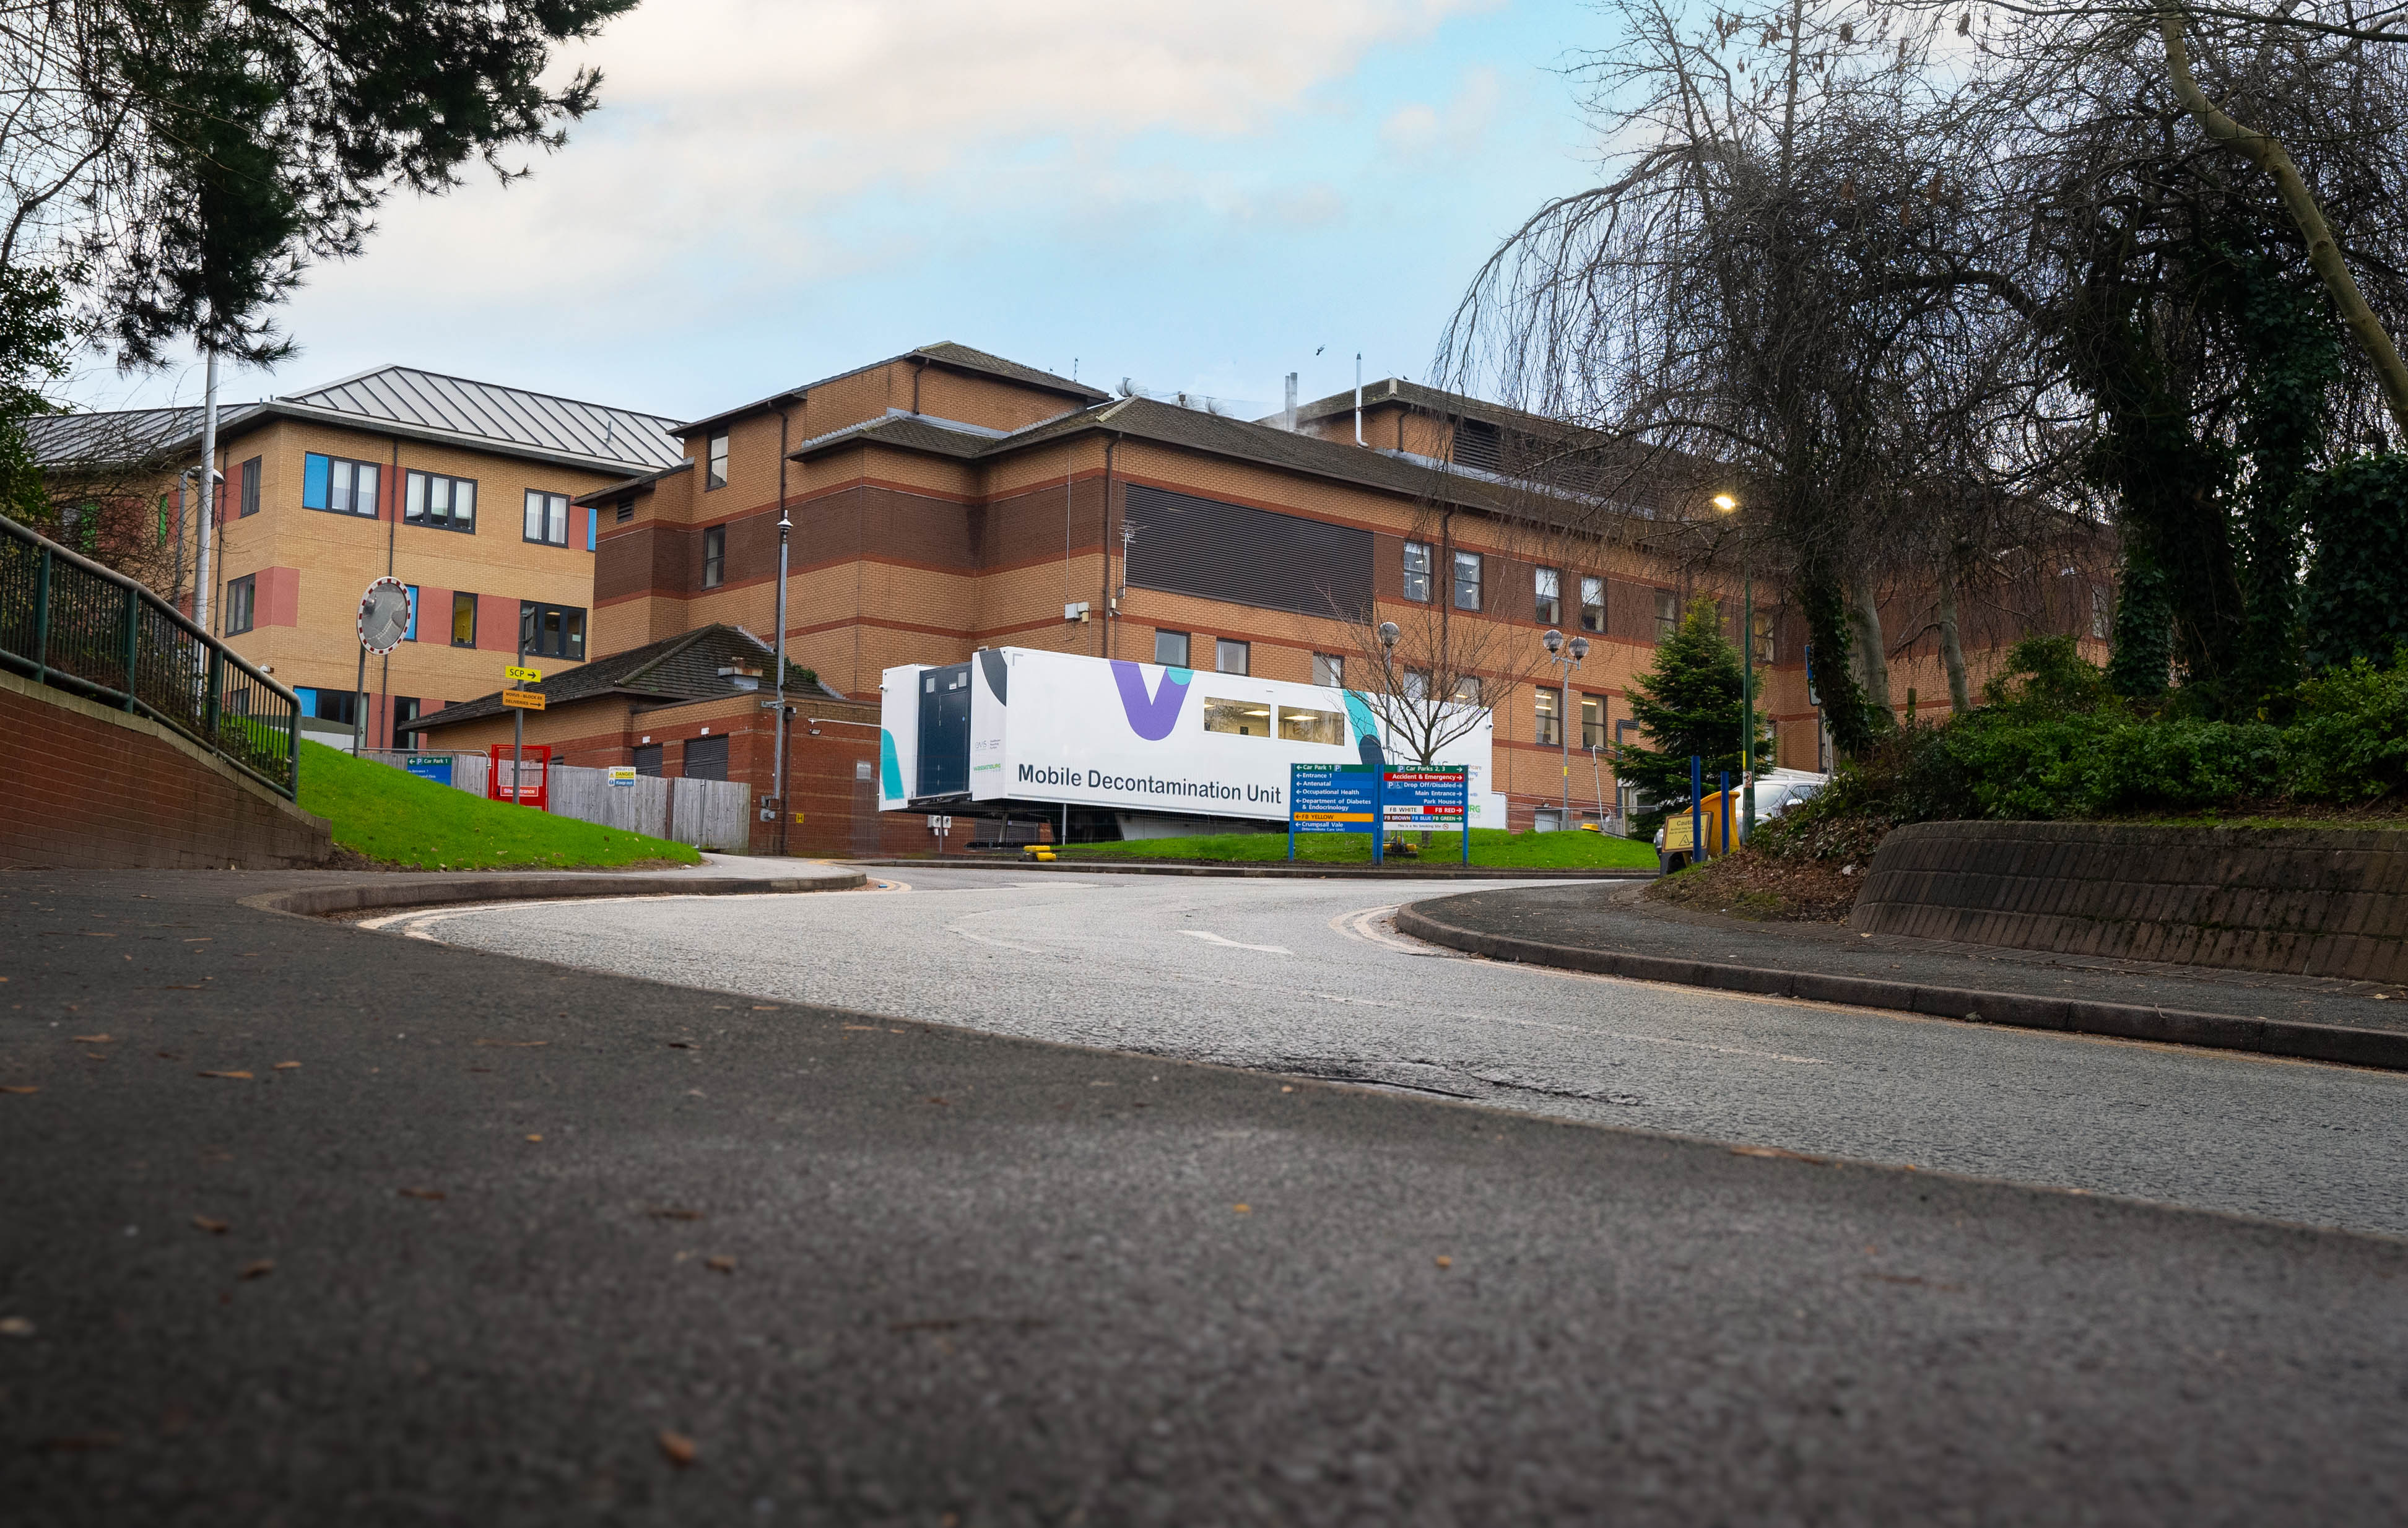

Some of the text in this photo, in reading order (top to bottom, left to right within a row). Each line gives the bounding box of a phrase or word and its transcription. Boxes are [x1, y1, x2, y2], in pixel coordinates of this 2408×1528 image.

[510, 669, 524, 677] SCP
[1018, 763, 1282, 804] Mobile Decontamination Unit
[797, 814, 803, 822] H
